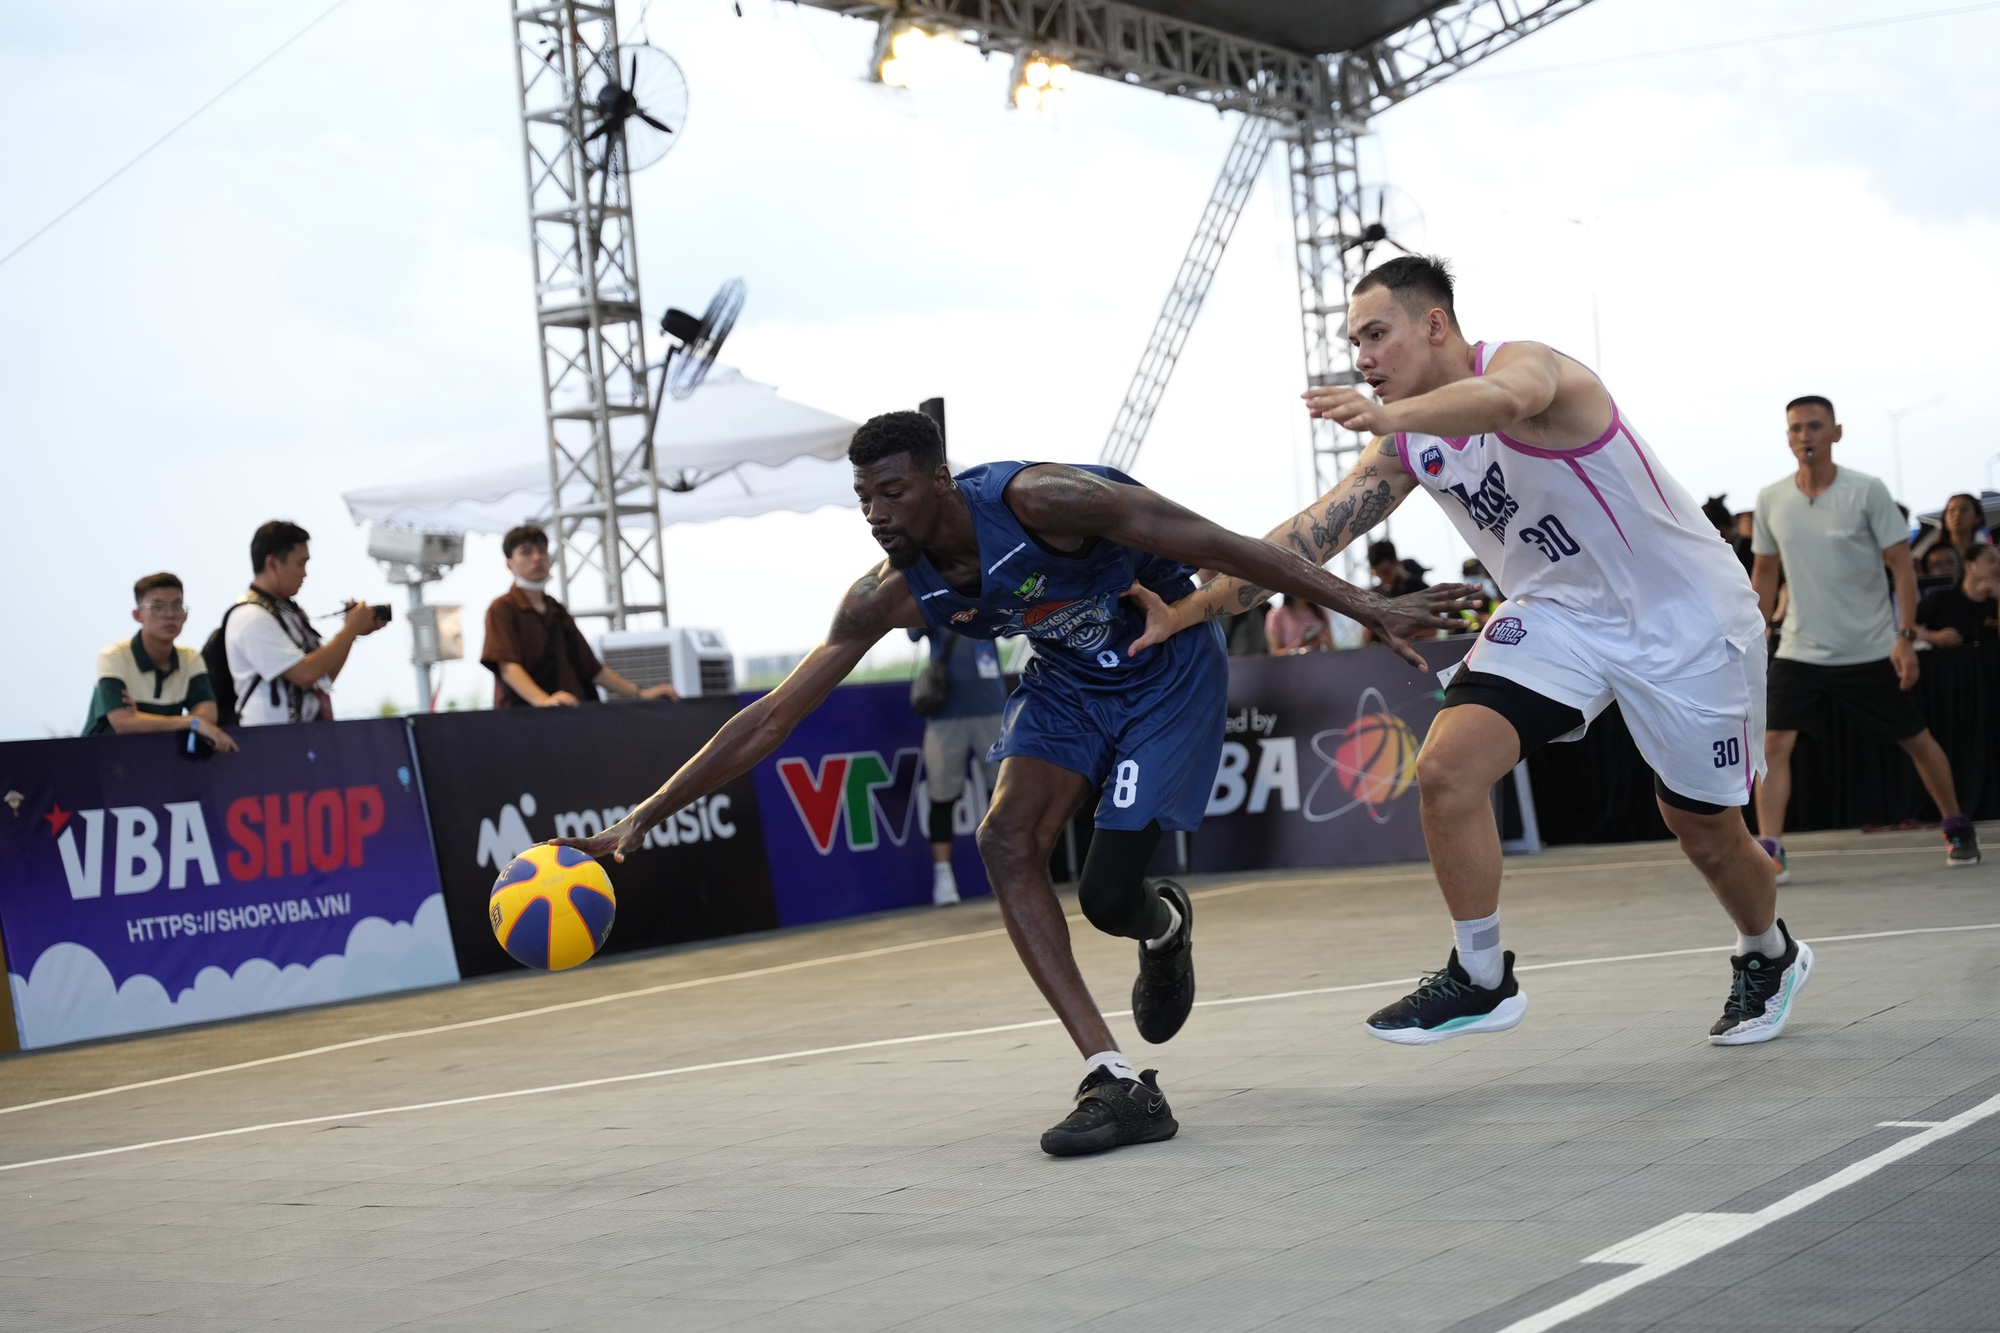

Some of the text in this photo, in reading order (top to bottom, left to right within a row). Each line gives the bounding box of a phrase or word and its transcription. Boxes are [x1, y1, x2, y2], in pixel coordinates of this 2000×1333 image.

[1519, 514, 1581, 563] 30
[1489, 622, 1525, 638] HOOP
[1251, 706, 1278, 736] by
[1203, 736, 1301, 817] BA
[1713, 737, 1740, 768] 30
[1113, 760, 1139, 808] 8
[57, 785, 385, 901] VBA SHOP
[127, 893, 352, 943] HTTPS://SHOP.VBA.VN/
